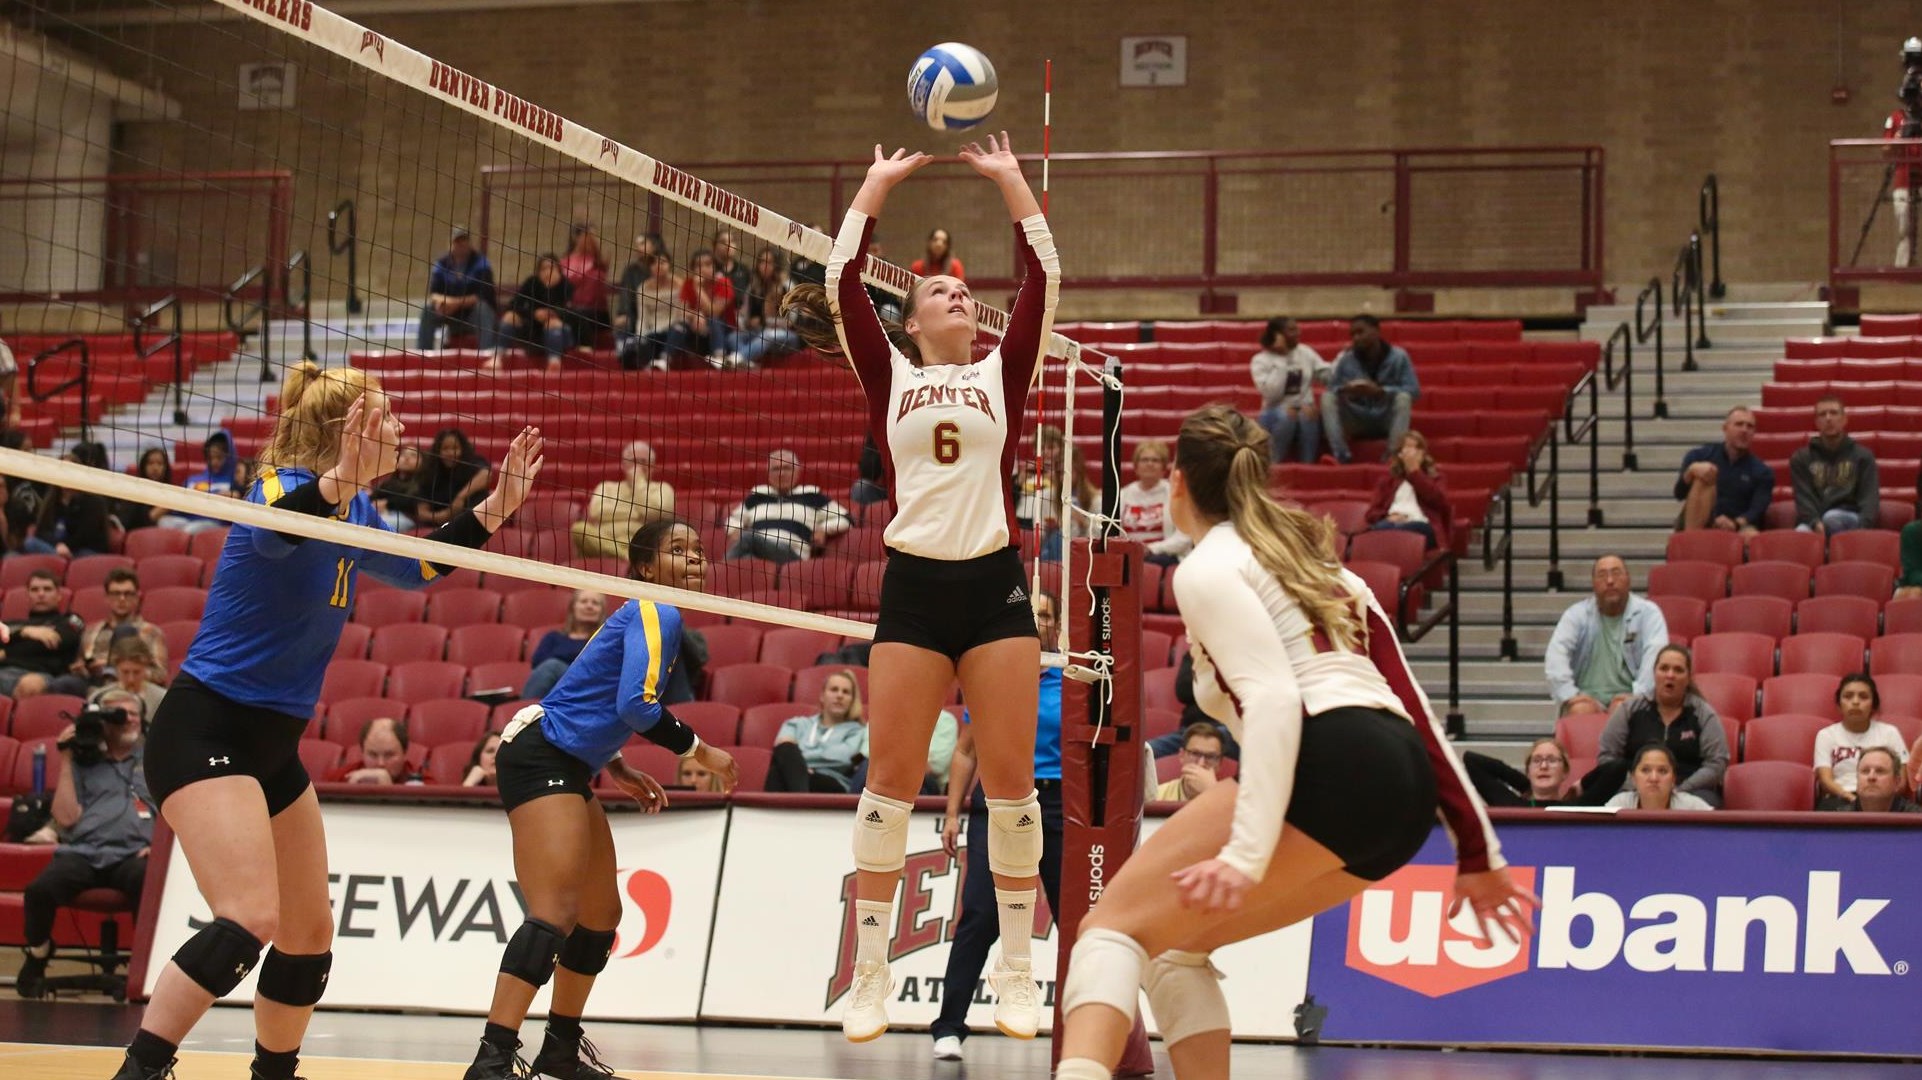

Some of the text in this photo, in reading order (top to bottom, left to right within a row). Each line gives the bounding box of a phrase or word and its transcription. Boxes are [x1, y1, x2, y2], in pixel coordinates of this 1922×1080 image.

[429, 59, 564, 142] DENVER PIONEERS
[653, 161, 760, 228] DENVER PIONEERS
[896, 383, 997, 425] DENVER
[932, 420, 962, 466] 6
[329, 557, 355, 609] 11
[1101, 597, 1112, 640] sports
[1088, 844, 1105, 901] sports
